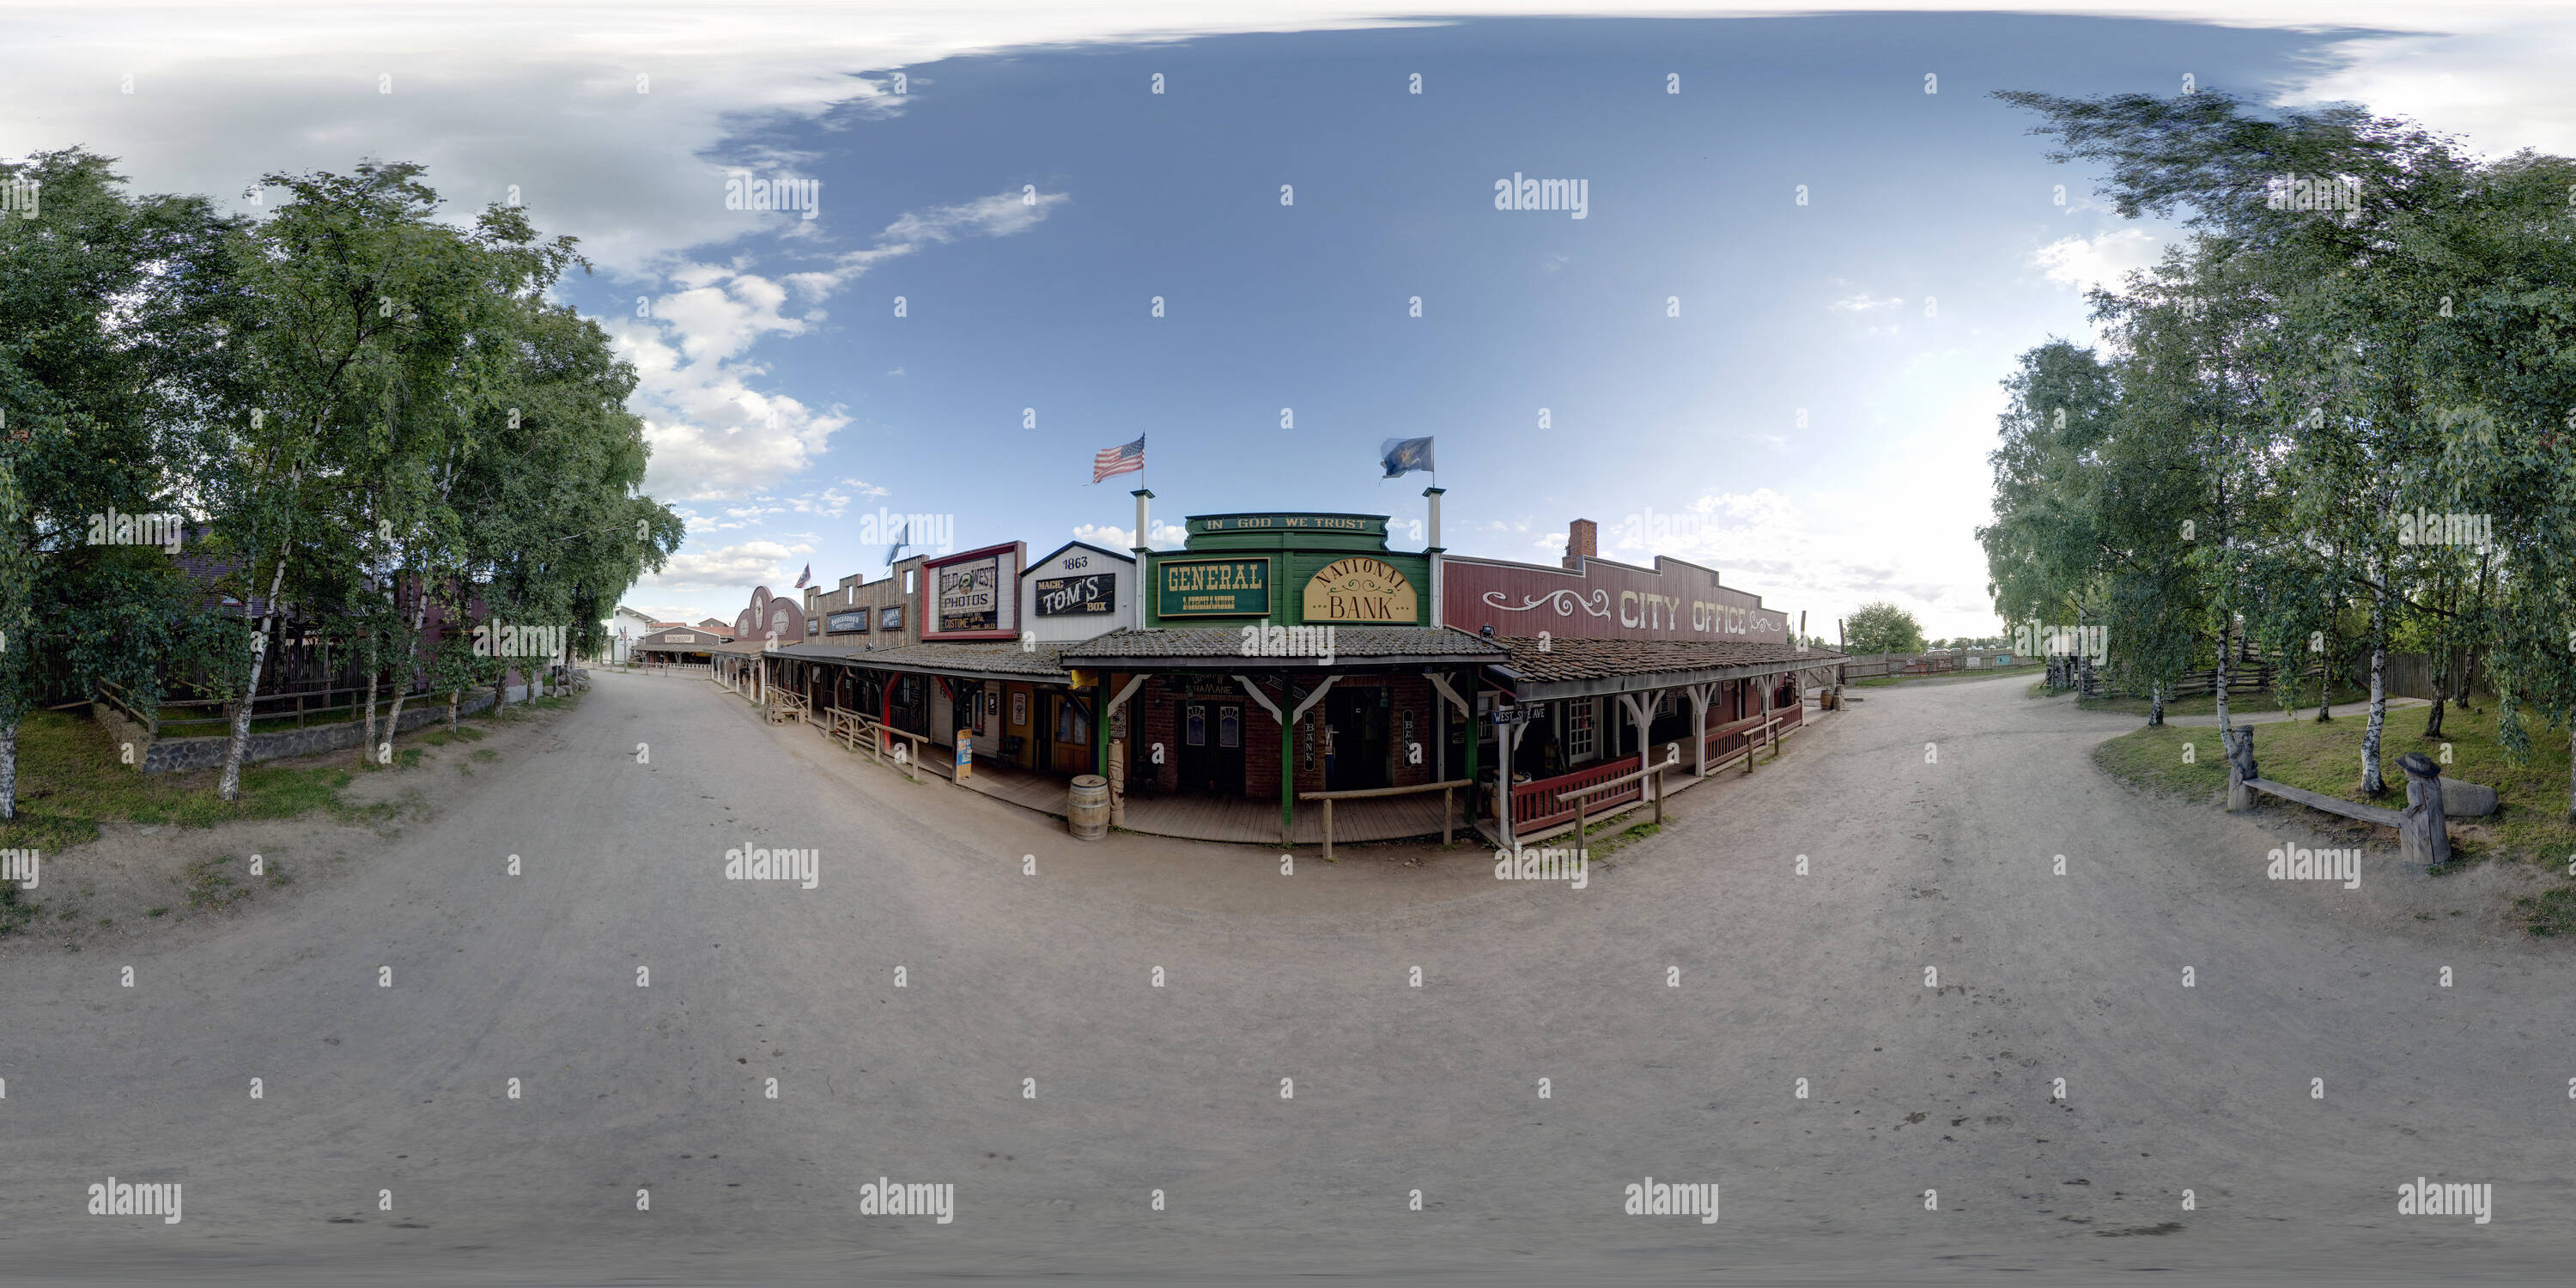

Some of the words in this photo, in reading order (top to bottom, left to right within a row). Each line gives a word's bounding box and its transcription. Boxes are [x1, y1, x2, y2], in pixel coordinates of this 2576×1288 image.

[1207, 519, 1223, 529] IN
[1237, 518, 1272, 528] GOD
[1286, 518, 1308, 527] WE
[1315, 518, 1366, 529] TRUST
[1063, 556, 1088, 570] 1863
[971, 567, 995, 588] WEST
[1169, 564, 1262, 592] GENERAL
[1315, 558, 1408, 592] NATIONAL
[1038, 580, 1065, 590] MAGIC
[945, 593, 988, 608] PHOTOS
[1043, 575, 1098, 614] TOM'S
[1086, 601, 1107, 611] BOX
[1330, 596, 1394, 620] BANK
[1620, 590, 1680, 630] CITY
[1692, 600, 1746, 635] OFFICE
[945, 617, 969, 629] COSTUME
[1494, 711, 1514, 722] WEST
[1517, 709, 1532, 720] SIE
[1533, 708, 1546, 719] AVE
[1305, 723, 1314, 762] BANK
